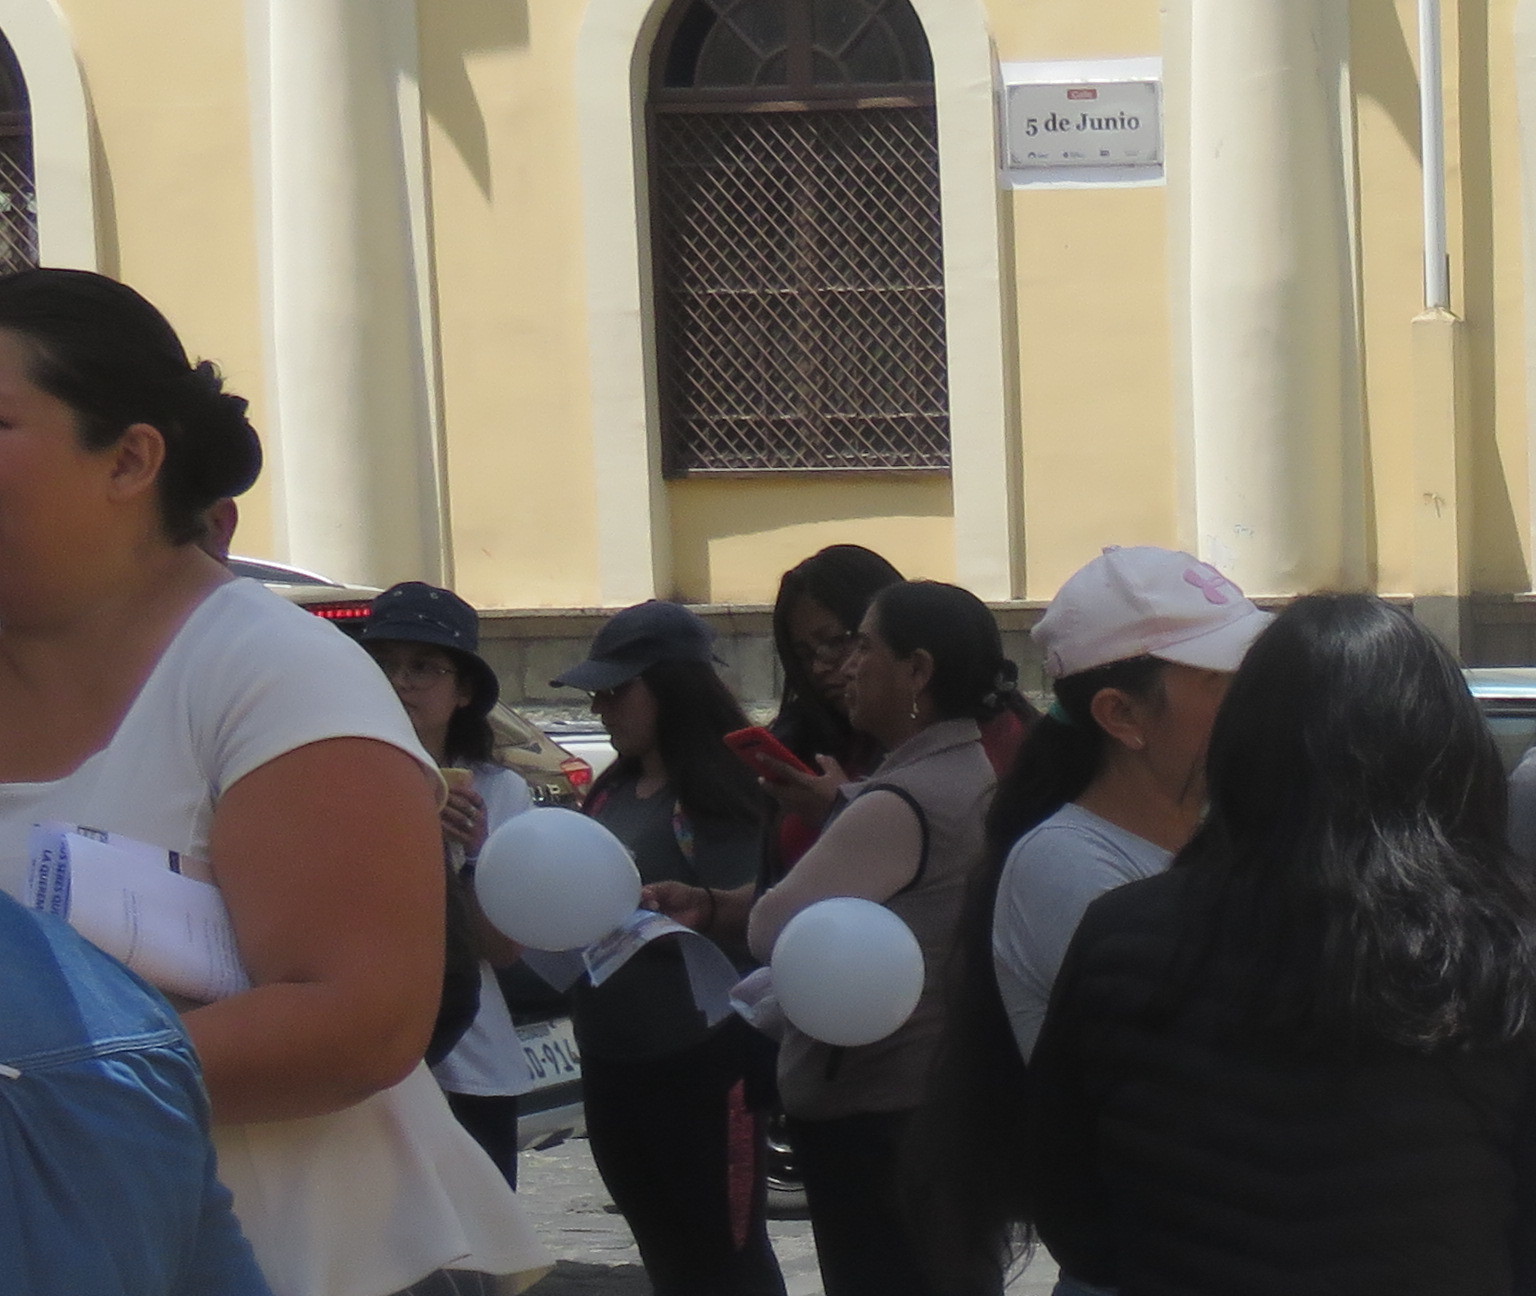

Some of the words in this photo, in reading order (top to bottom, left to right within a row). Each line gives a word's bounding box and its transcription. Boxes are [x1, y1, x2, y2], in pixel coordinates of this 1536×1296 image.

[1025, 118, 1038, 137] 5
[1044, 112, 1070, 132] de
[1076, 110, 1140, 131] Junio
